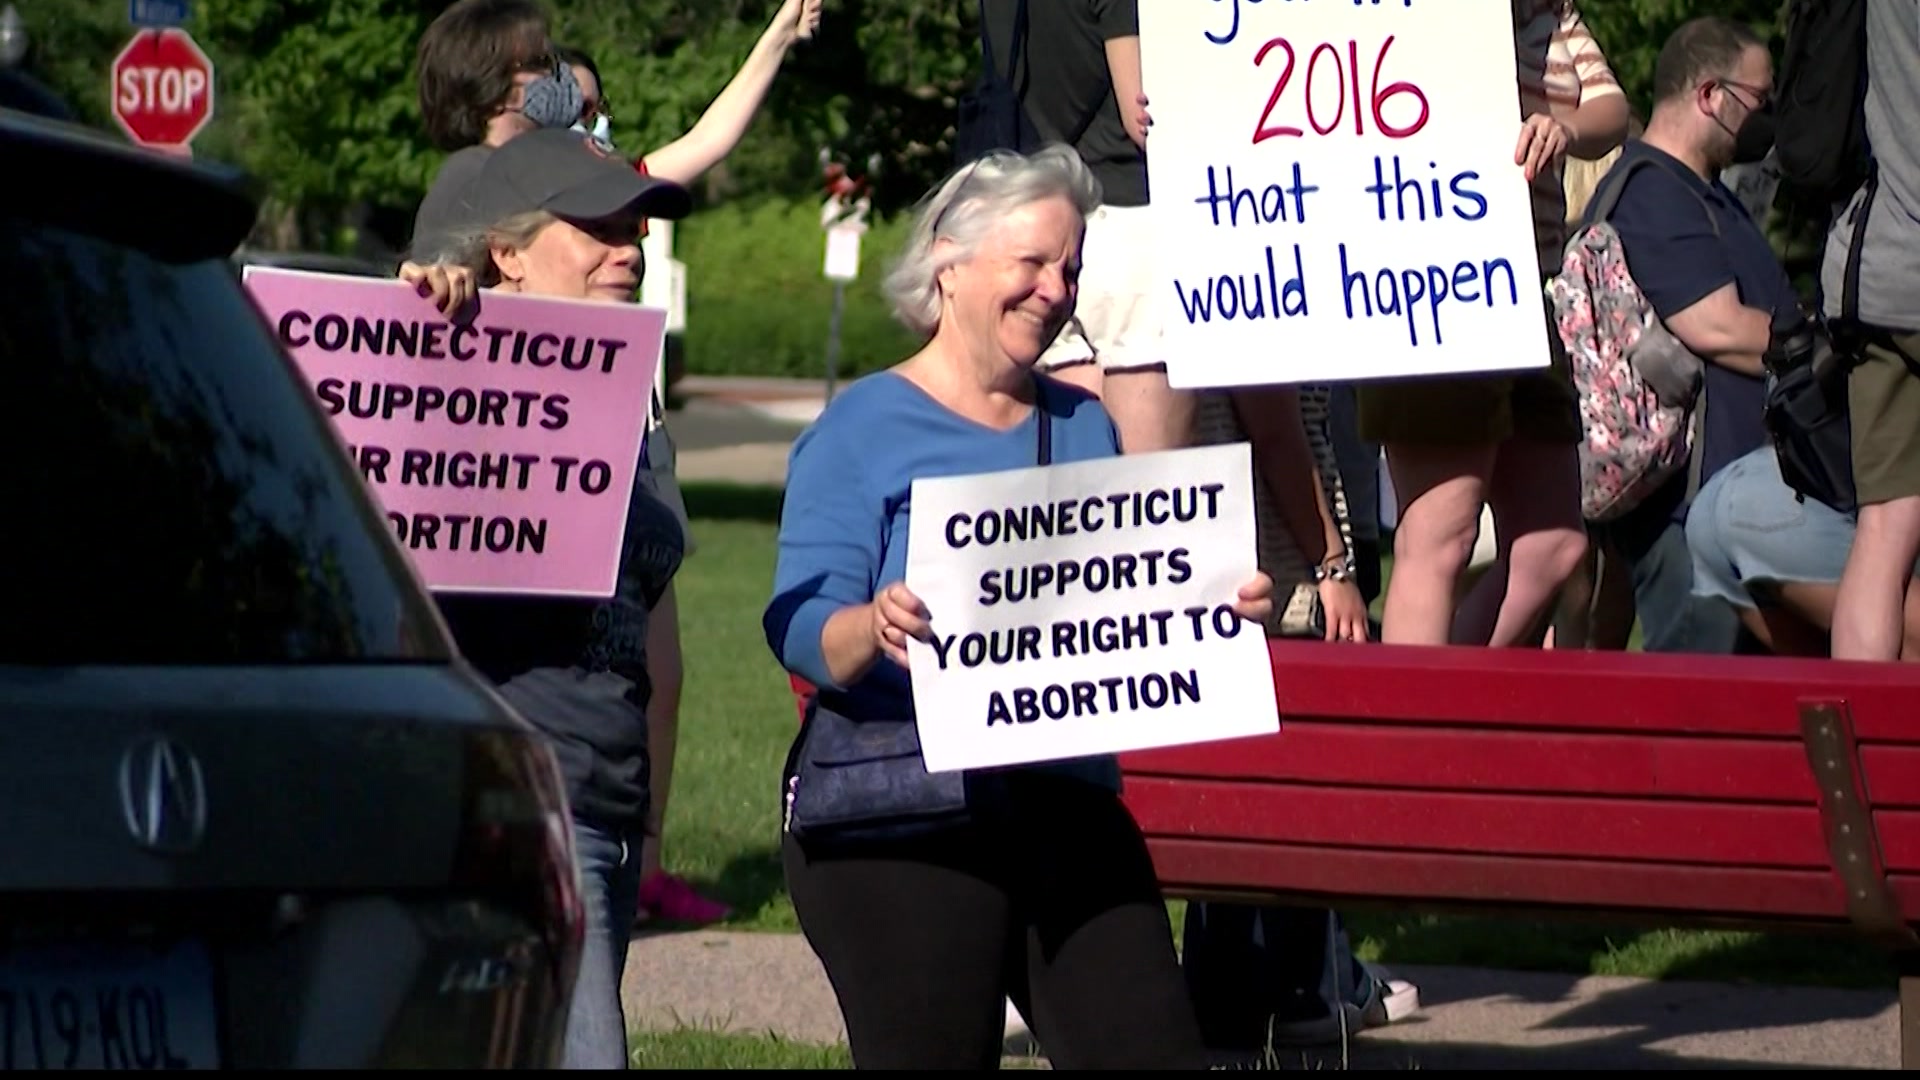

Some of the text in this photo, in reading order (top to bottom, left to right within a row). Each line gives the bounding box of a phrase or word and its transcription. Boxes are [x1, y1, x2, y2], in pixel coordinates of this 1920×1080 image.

[120, 66, 206, 113] STOP
[1252, 35, 1430, 144] 2016
[1195, 156, 1488, 226] that this
[1174, 242, 1518, 347] would happen
[278, 309, 628, 374] CONNECTICUT
[316, 377, 571, 431] SUPPORTS
[401, 449, 541, 490] RIGHT
[550, 456, 612, 496] TO
[386, 511, 548, 554] ORTION
[945, 483, 1225, 549] CONNECTICUT
[979, 547, 1193, 606] SUPPORTS
[930, 603, 1242, 670] YOUR RIGHT TO
[986, 669, 1202, 727] ABORTION
